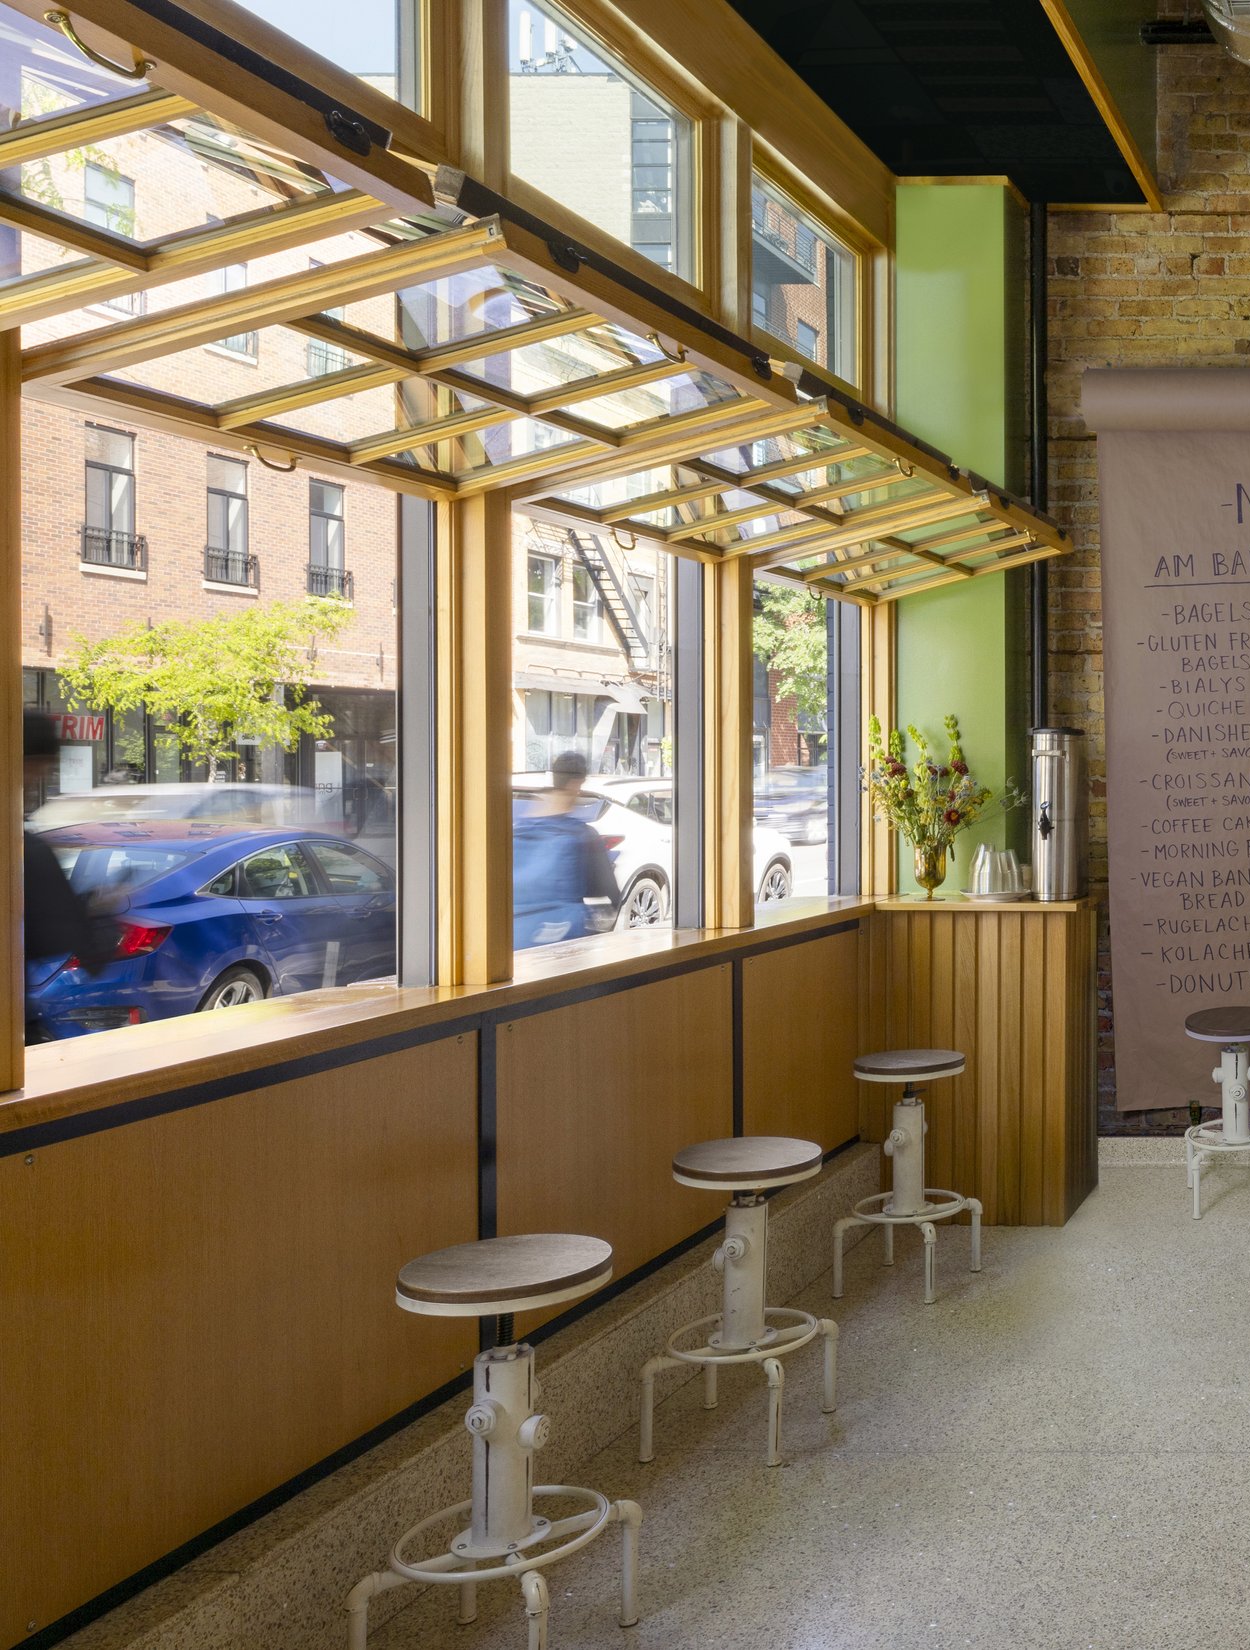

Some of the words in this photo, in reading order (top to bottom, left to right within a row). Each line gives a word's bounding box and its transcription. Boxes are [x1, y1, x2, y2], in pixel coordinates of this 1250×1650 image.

[1154, 554, 1195, 578] AM
[1182, 655, 1250, 672] BAGELS
[1166, 748, 1208, 763] (SWEET
[1166, 795, 1208, 808] (SWEET
[1180, 891, 1245, 910] BREAD
